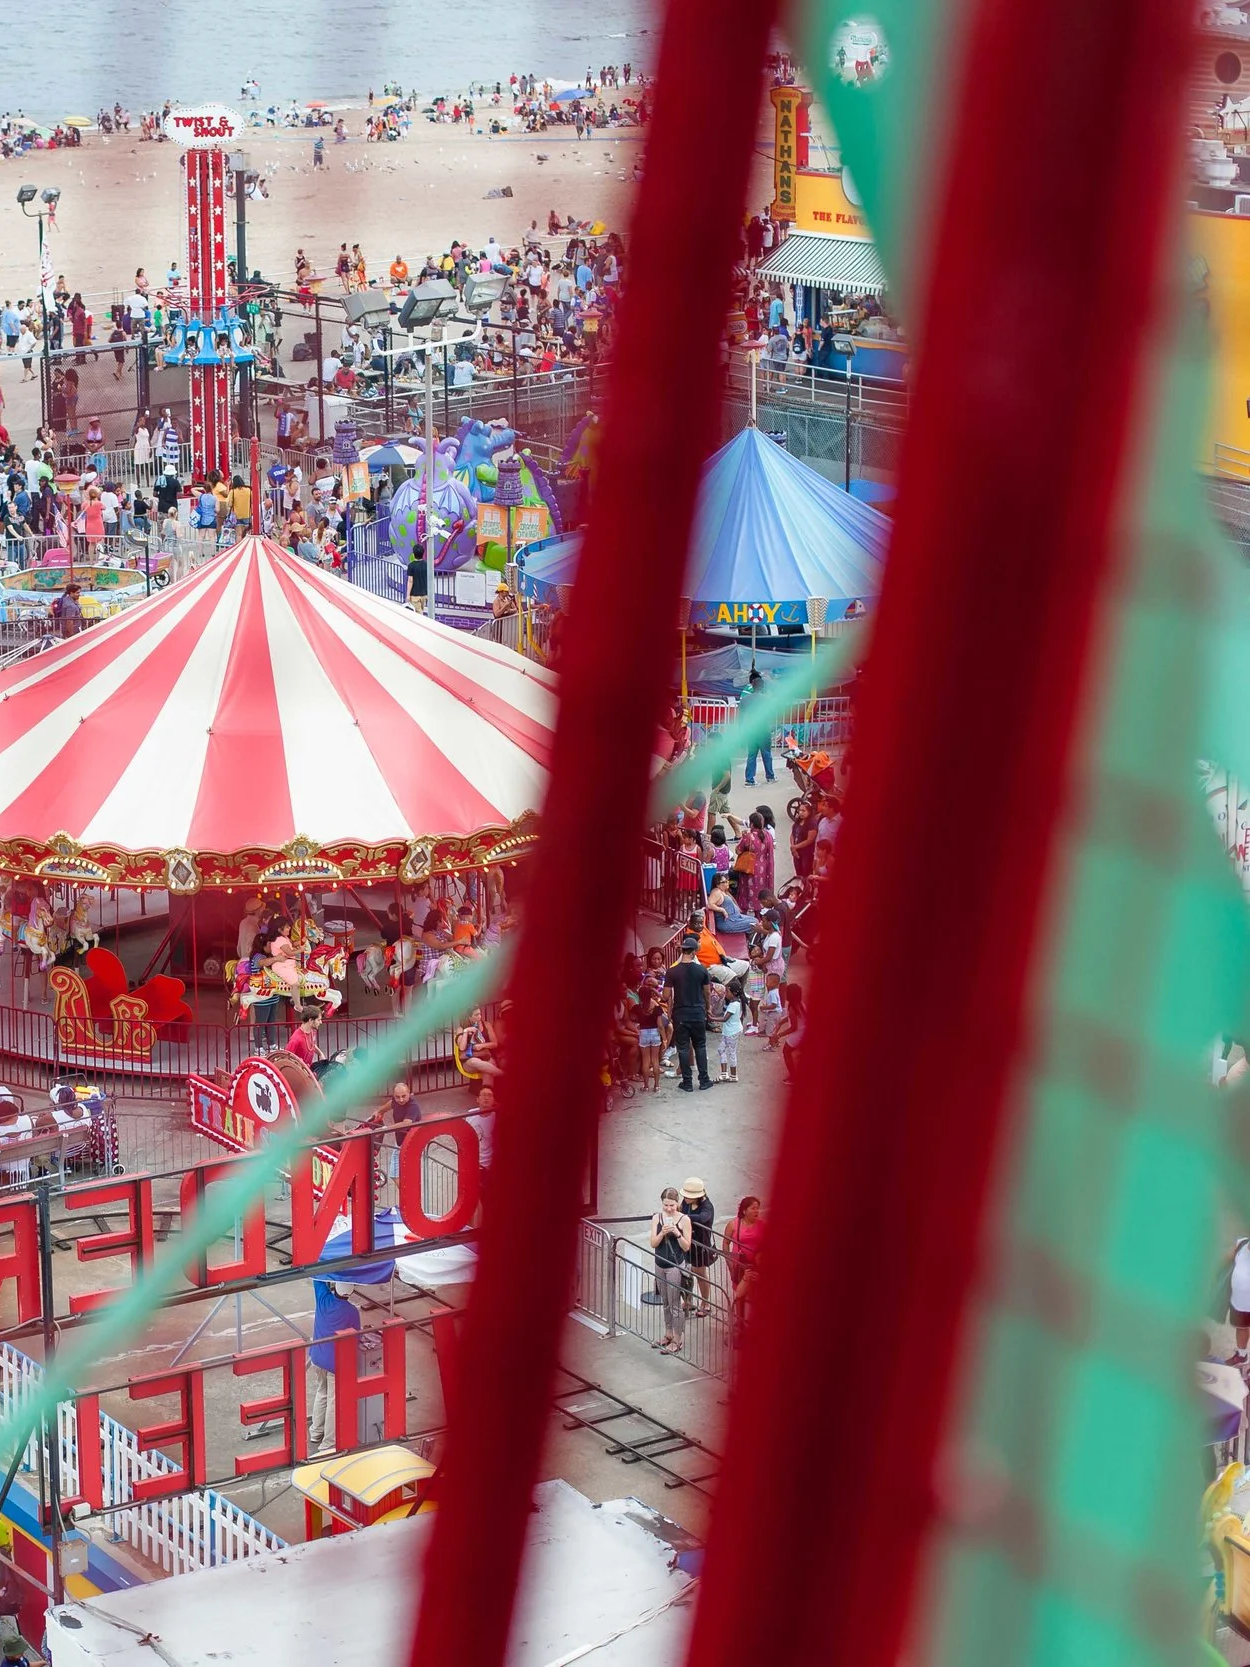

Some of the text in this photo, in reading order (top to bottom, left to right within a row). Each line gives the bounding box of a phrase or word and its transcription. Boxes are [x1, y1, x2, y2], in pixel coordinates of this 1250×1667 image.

[173, 116, 229, 127] TWIST &
[193, 127, 235, 137] SHOUT
[780, 100, 792, 203] NATHANS
[813, 211, 832, 222] THE
[716, 603, 781, 624] AHOY
[680, 859, 696, 873] EXIT
[198, 1093, 255, 1149] TRAIN
[584, 1225, 602, 1244] EXIT
